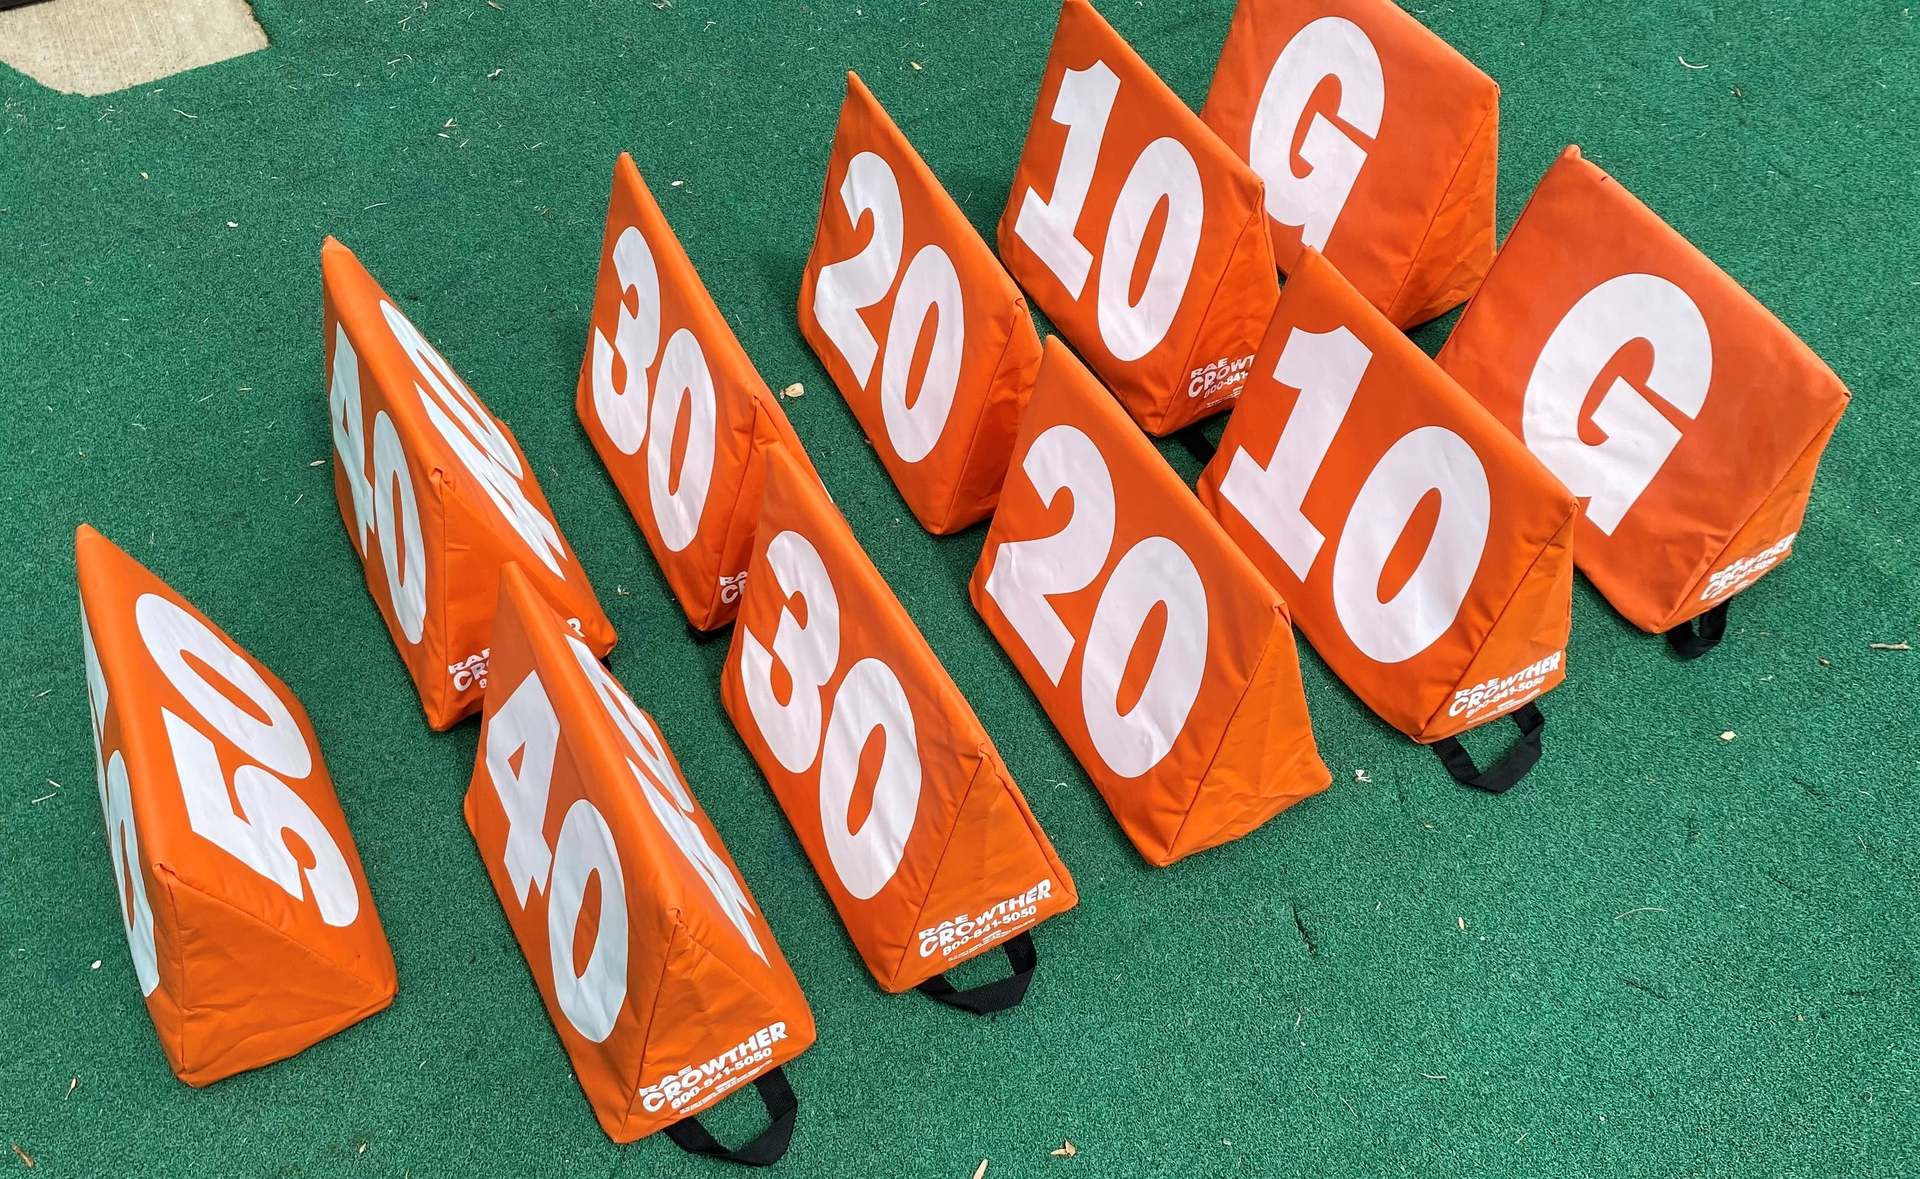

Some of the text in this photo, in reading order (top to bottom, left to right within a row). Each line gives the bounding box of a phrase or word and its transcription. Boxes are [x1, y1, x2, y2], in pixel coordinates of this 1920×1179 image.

[1014, 59, 1204, 362] 10
[1248, 15, 1386, 254] G
[592, 226, 717, 552] 30
[813, 151, 965, 463] 20
[1187, 353, 1256, 398] CROWT
[1190, 357, 1229, 379] RAE
[1522, 273, 1713, 536] G
[329, 321, 427, 644] 40
[985, 425, 1208, 778] 20
[1219, 325, 1491, 663] 10
[135, 593, 359, 927] 50
[741, 530, 922, 900] 30
[1448, 650, 1562, 718] CROWTHER
[1454, 677, 1500, 700] RAE
[485, 670, 629, 1043] 40
[917, 913, 969, 941] RAE
[918, 878, 1052, 958] CROWTHER
[942, 905, 1038, 957] 800-841-5050
[638, 1064, 694, 1097] RAE
[641, 1020, 789, 1113] CROWTHER
[670, 1047, 773, 1110] 800-841-5050
